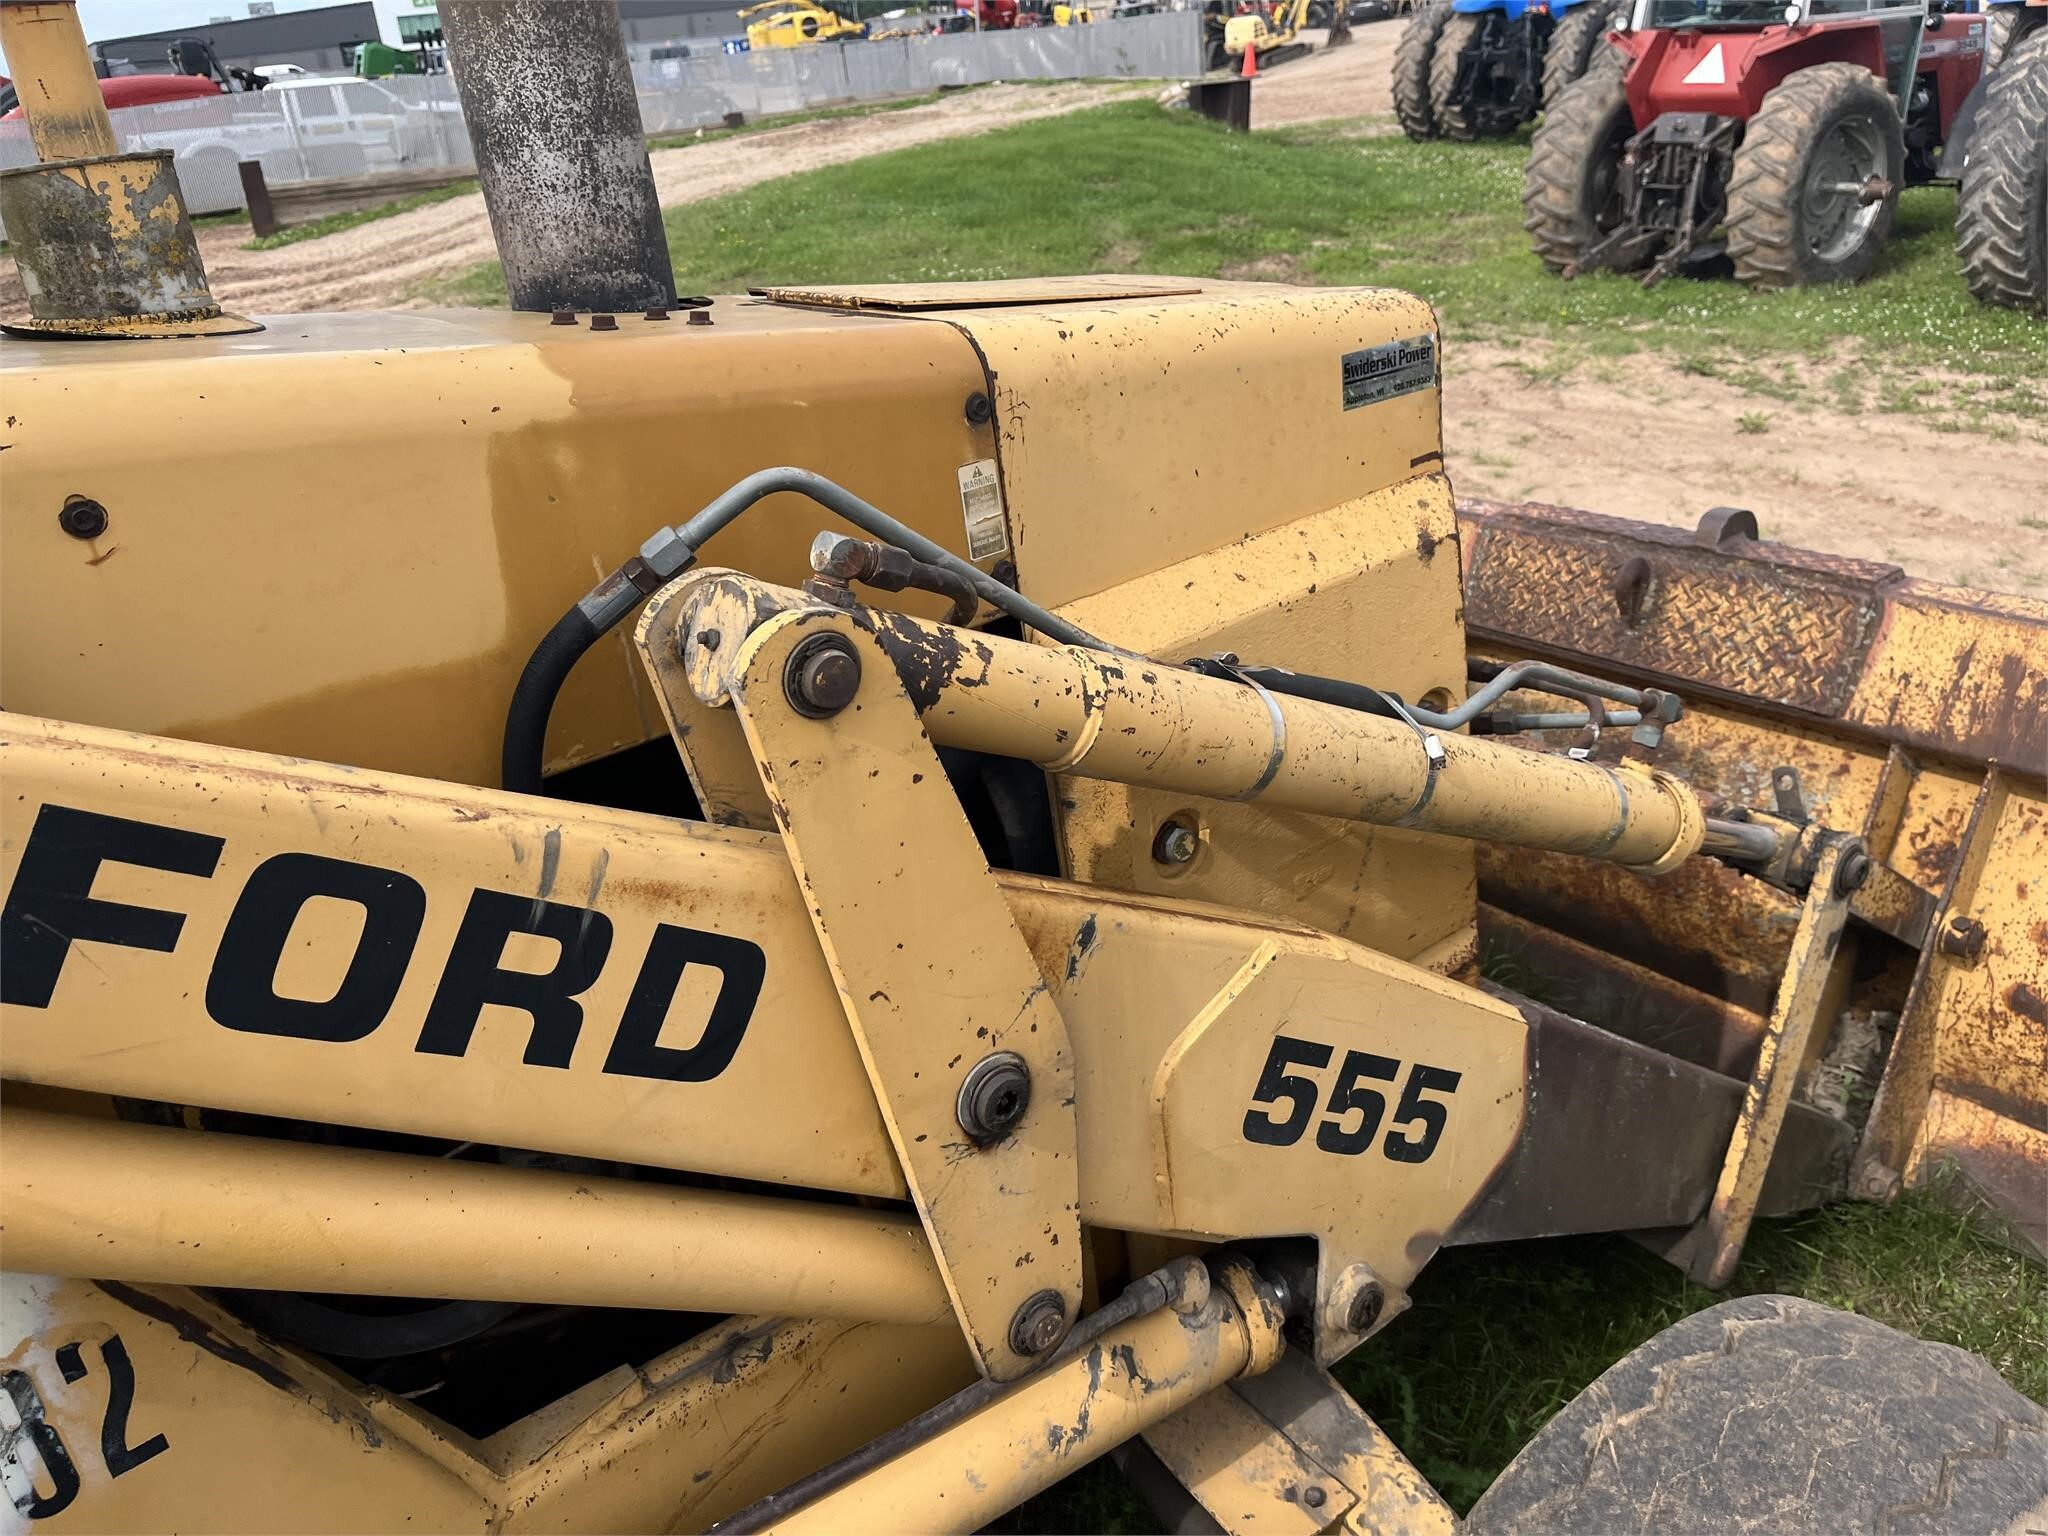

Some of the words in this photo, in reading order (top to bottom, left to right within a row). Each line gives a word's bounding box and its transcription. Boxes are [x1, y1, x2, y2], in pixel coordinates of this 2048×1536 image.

[1343, 351, 1396, 379] Swiderski
[1399, 346, 1432, 366] Power
[962, 474, 995, 490] WARNING
[0, 804, 767, 1083] FORD
[1243, 1035, 1463, 1164] 555
